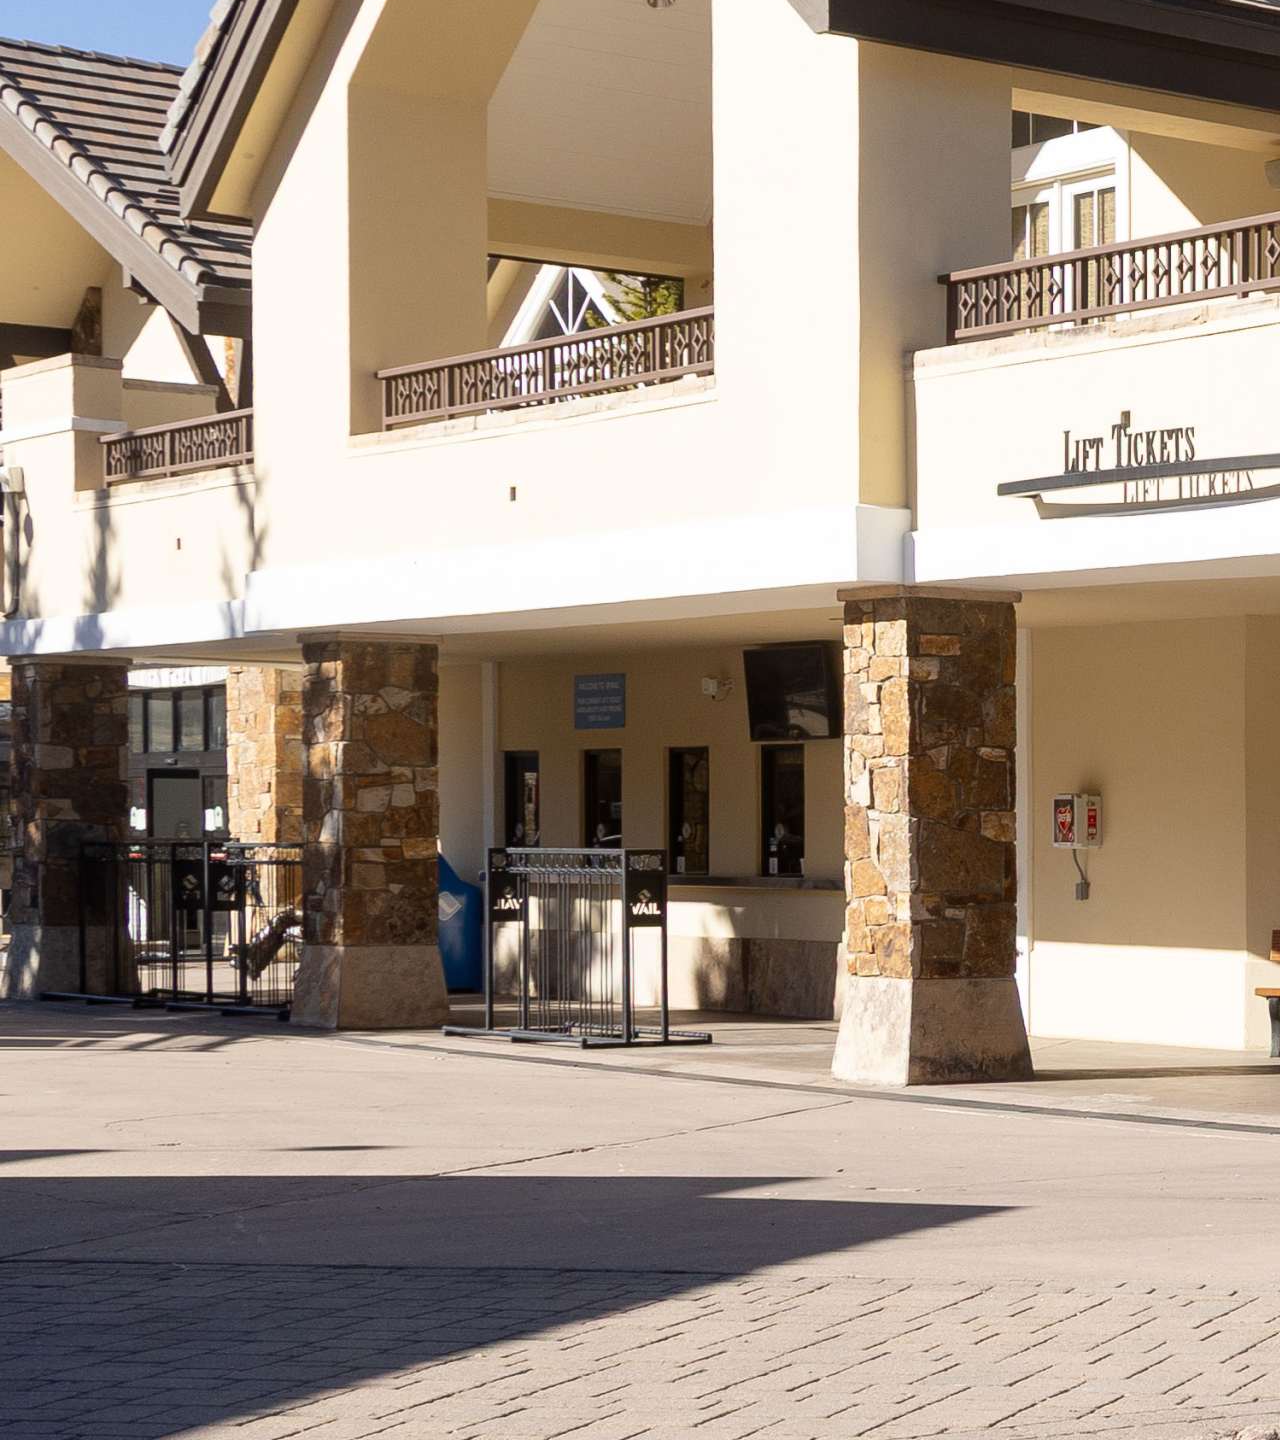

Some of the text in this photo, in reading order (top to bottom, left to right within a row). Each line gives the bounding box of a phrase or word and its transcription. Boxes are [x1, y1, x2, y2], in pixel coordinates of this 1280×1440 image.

[1063, 423, 1196, 474] LIFT TICKETS
[629, 902, 661, 915] VAIL
